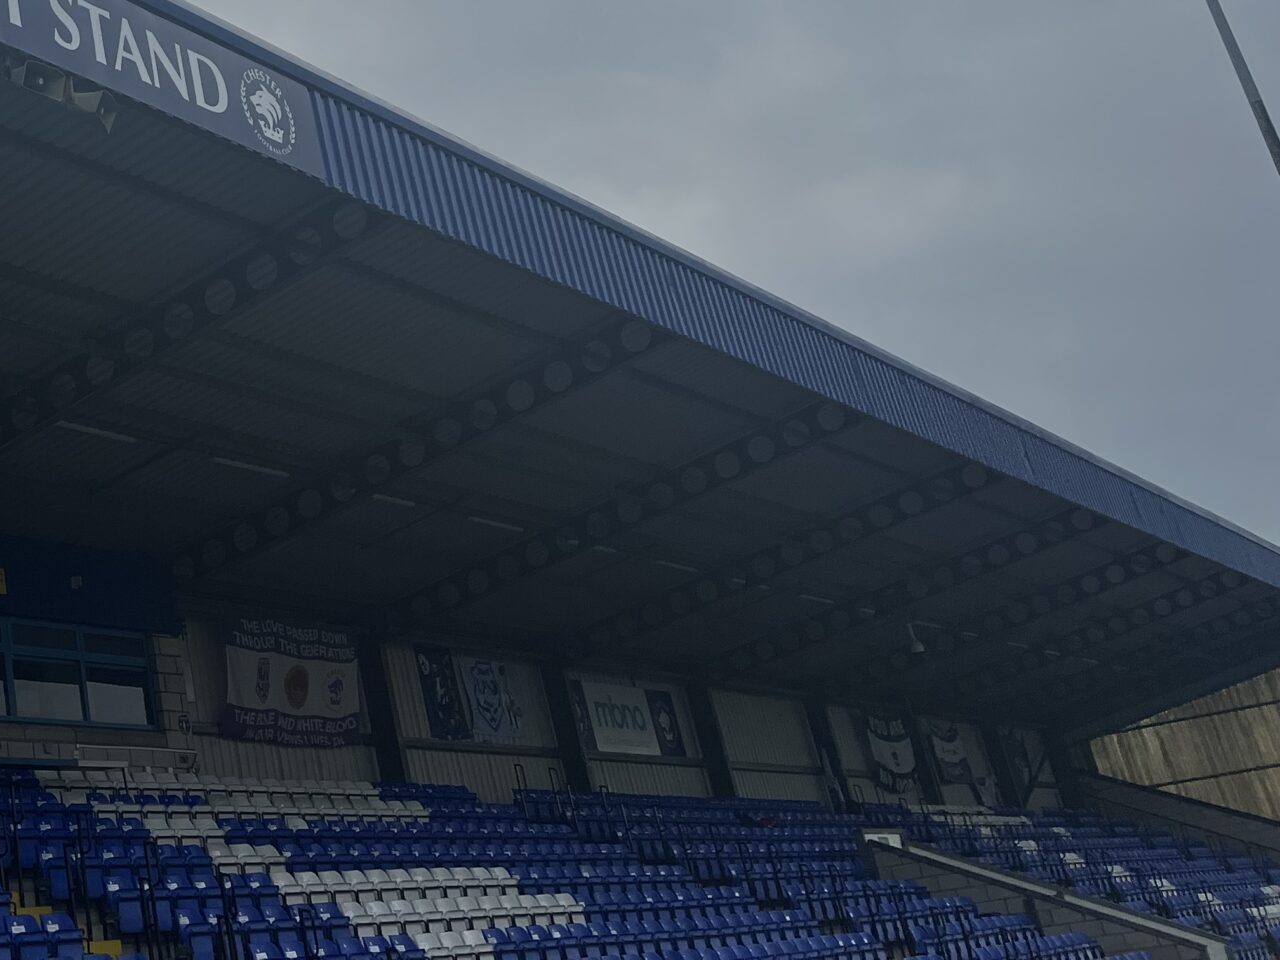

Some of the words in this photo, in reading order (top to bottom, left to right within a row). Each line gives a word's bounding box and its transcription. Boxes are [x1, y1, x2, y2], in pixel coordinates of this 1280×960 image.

[243, 68, 282, 98] CHESTER
[240, 618, 260, 633] THE
[261, 619, 285, 636] LOVE
[279, 639, 299, 656] THE
[233, 710, 256, 725] THE
[593, 695, 648, 731] mbna
